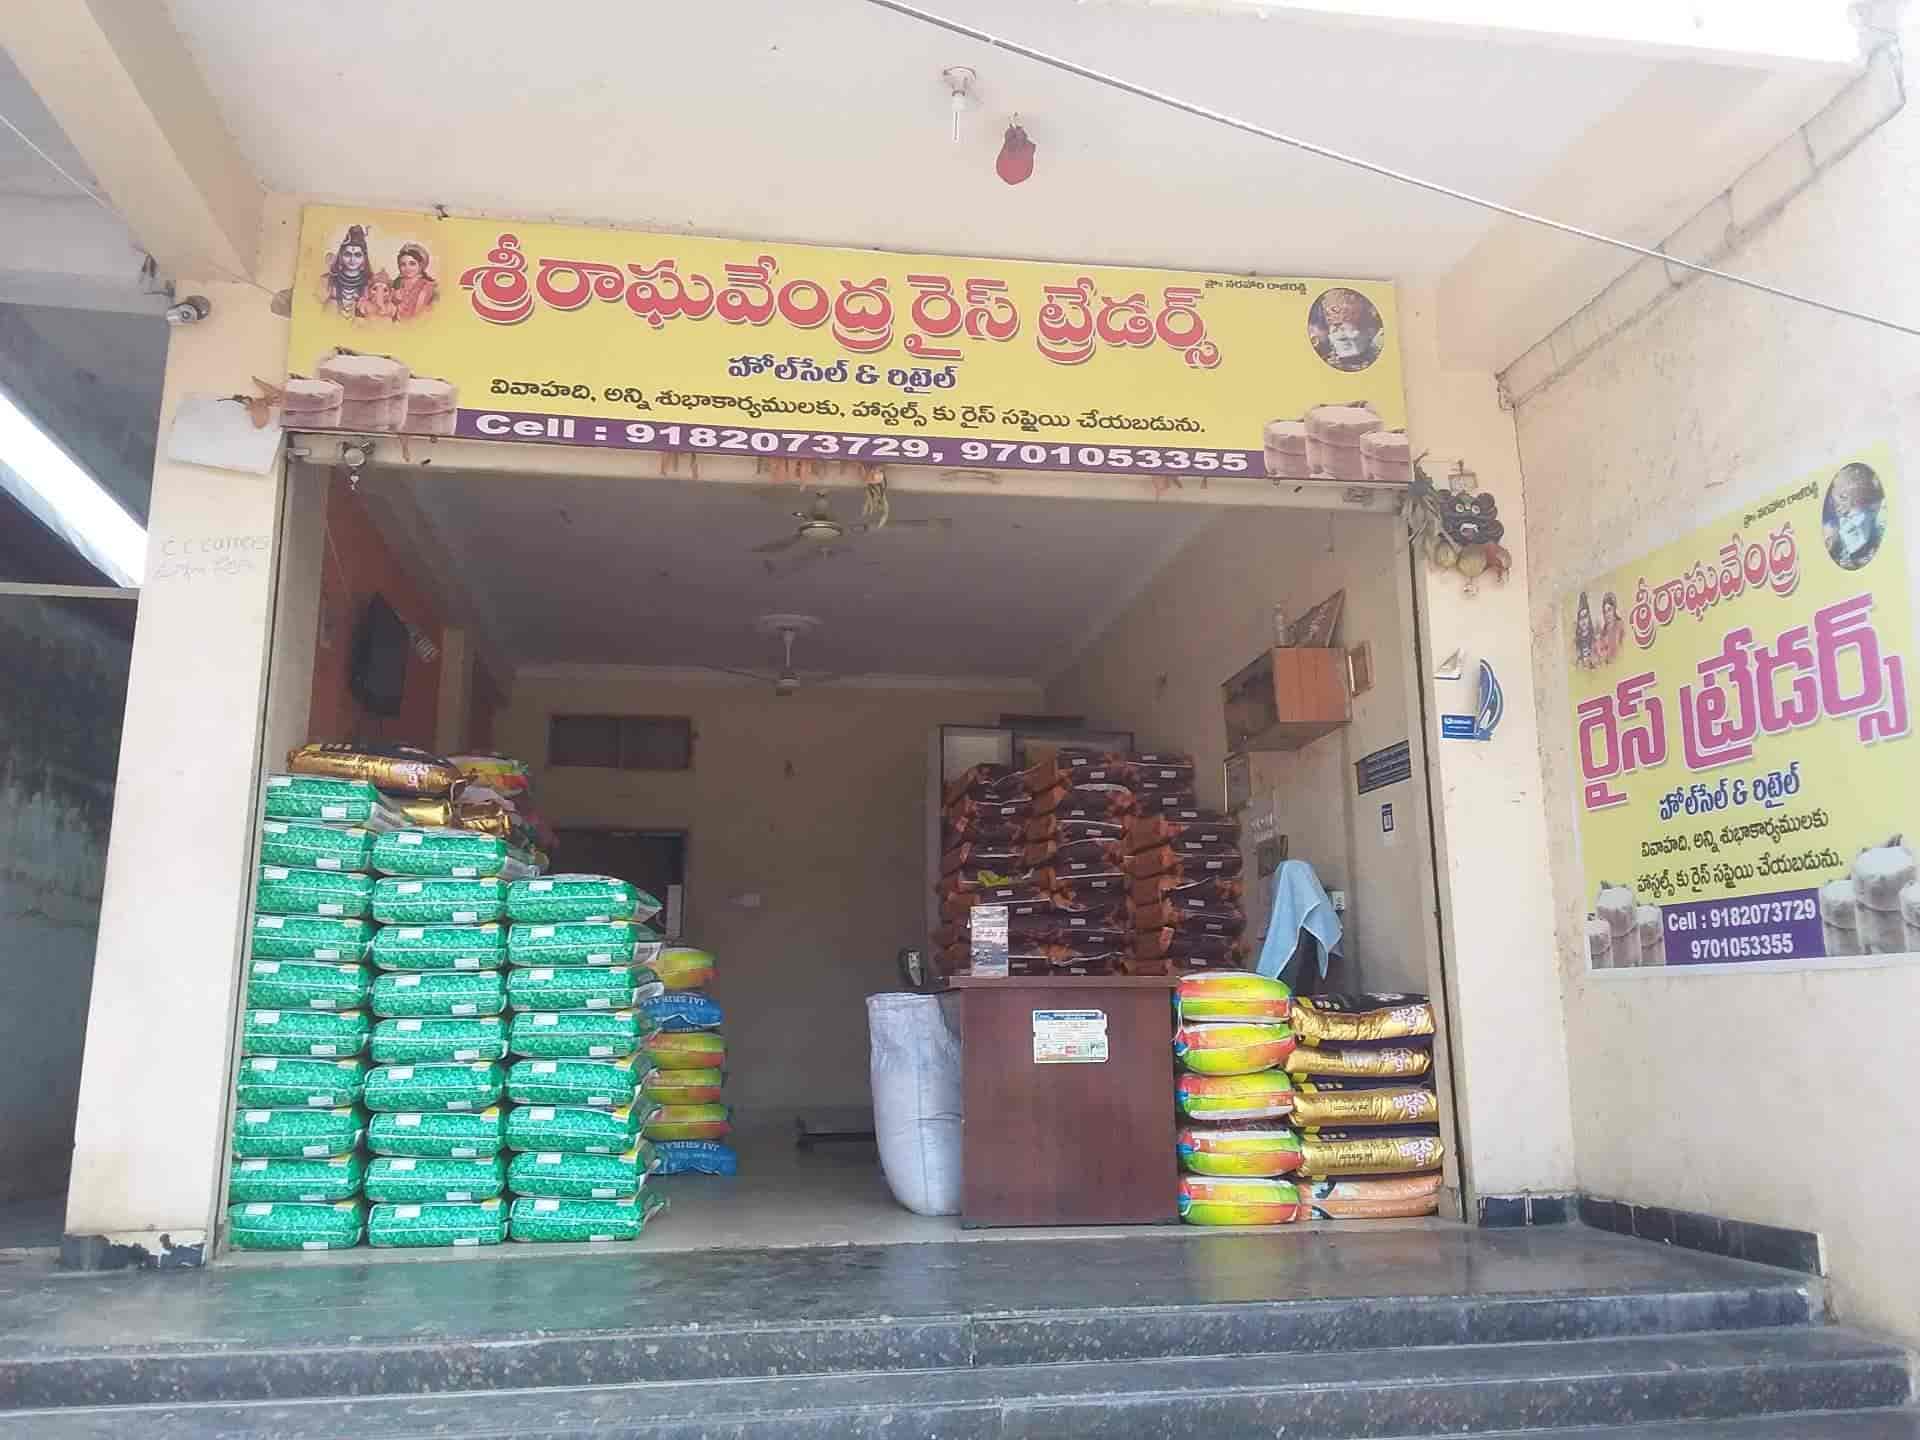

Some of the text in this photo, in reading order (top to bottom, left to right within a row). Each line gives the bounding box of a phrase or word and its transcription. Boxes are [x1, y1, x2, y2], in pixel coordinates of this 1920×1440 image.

[903, 273, 1020, 360] రైస్
[1036, 276, 1223, 369] ట్రేడర్స్
[855, 364, 881, 386] &
[603, 384, 652, 412] అన్ని
[932, 405, 957, 425] కు
[960, 403, 997, 431] రైస్
[475, 412, 575, 440] Cell
[625, 423, 945, 463] 9182073729,
[960, 439, 1250, 474] 9701053355
[1576, 593, 1911, 811] రైస్ ట్రేడర్స్
[1732, 781, 1748, 806] &
[1693, 830, 1720, 853] అన్ని
[1690, 863, 1711, 893] రైస్
[1667, 911, 1697, 932] Cell
[1711, 898, 1817, 930] 9182073729
[1690, 932, 1794, 959] 9701053355
